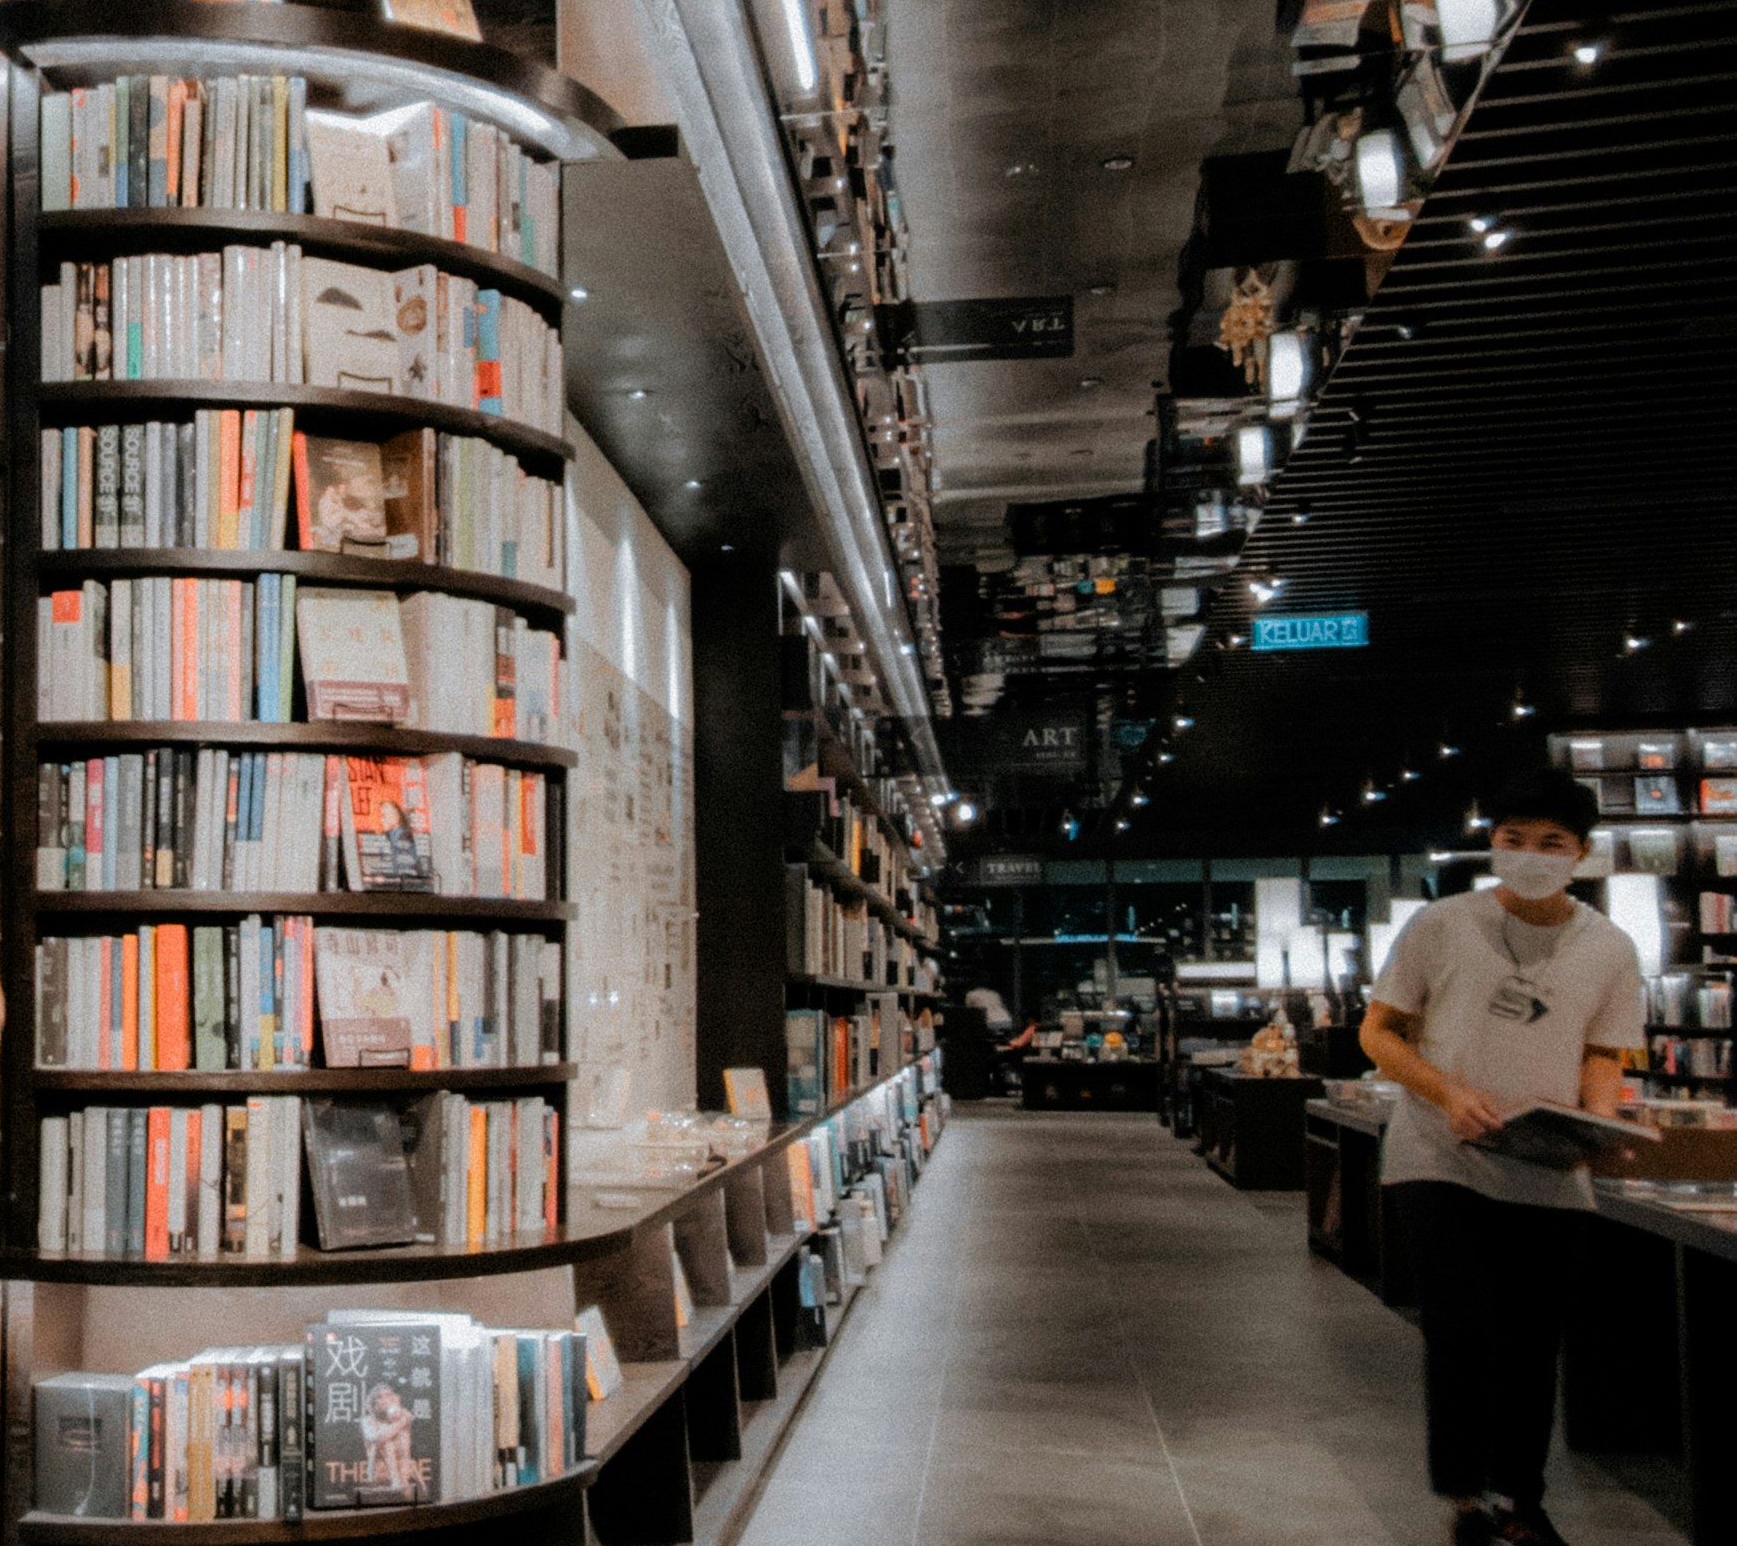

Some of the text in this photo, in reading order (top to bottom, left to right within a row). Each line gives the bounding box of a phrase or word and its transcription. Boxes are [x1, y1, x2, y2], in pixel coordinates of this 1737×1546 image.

[1260, 620, 1339, 644] KELUAR
[1022, 726, 1078, 747] ART
[987, 861, 1041, 874] TRAVEL
[325, 1335, 368, 1424] 戏剧
